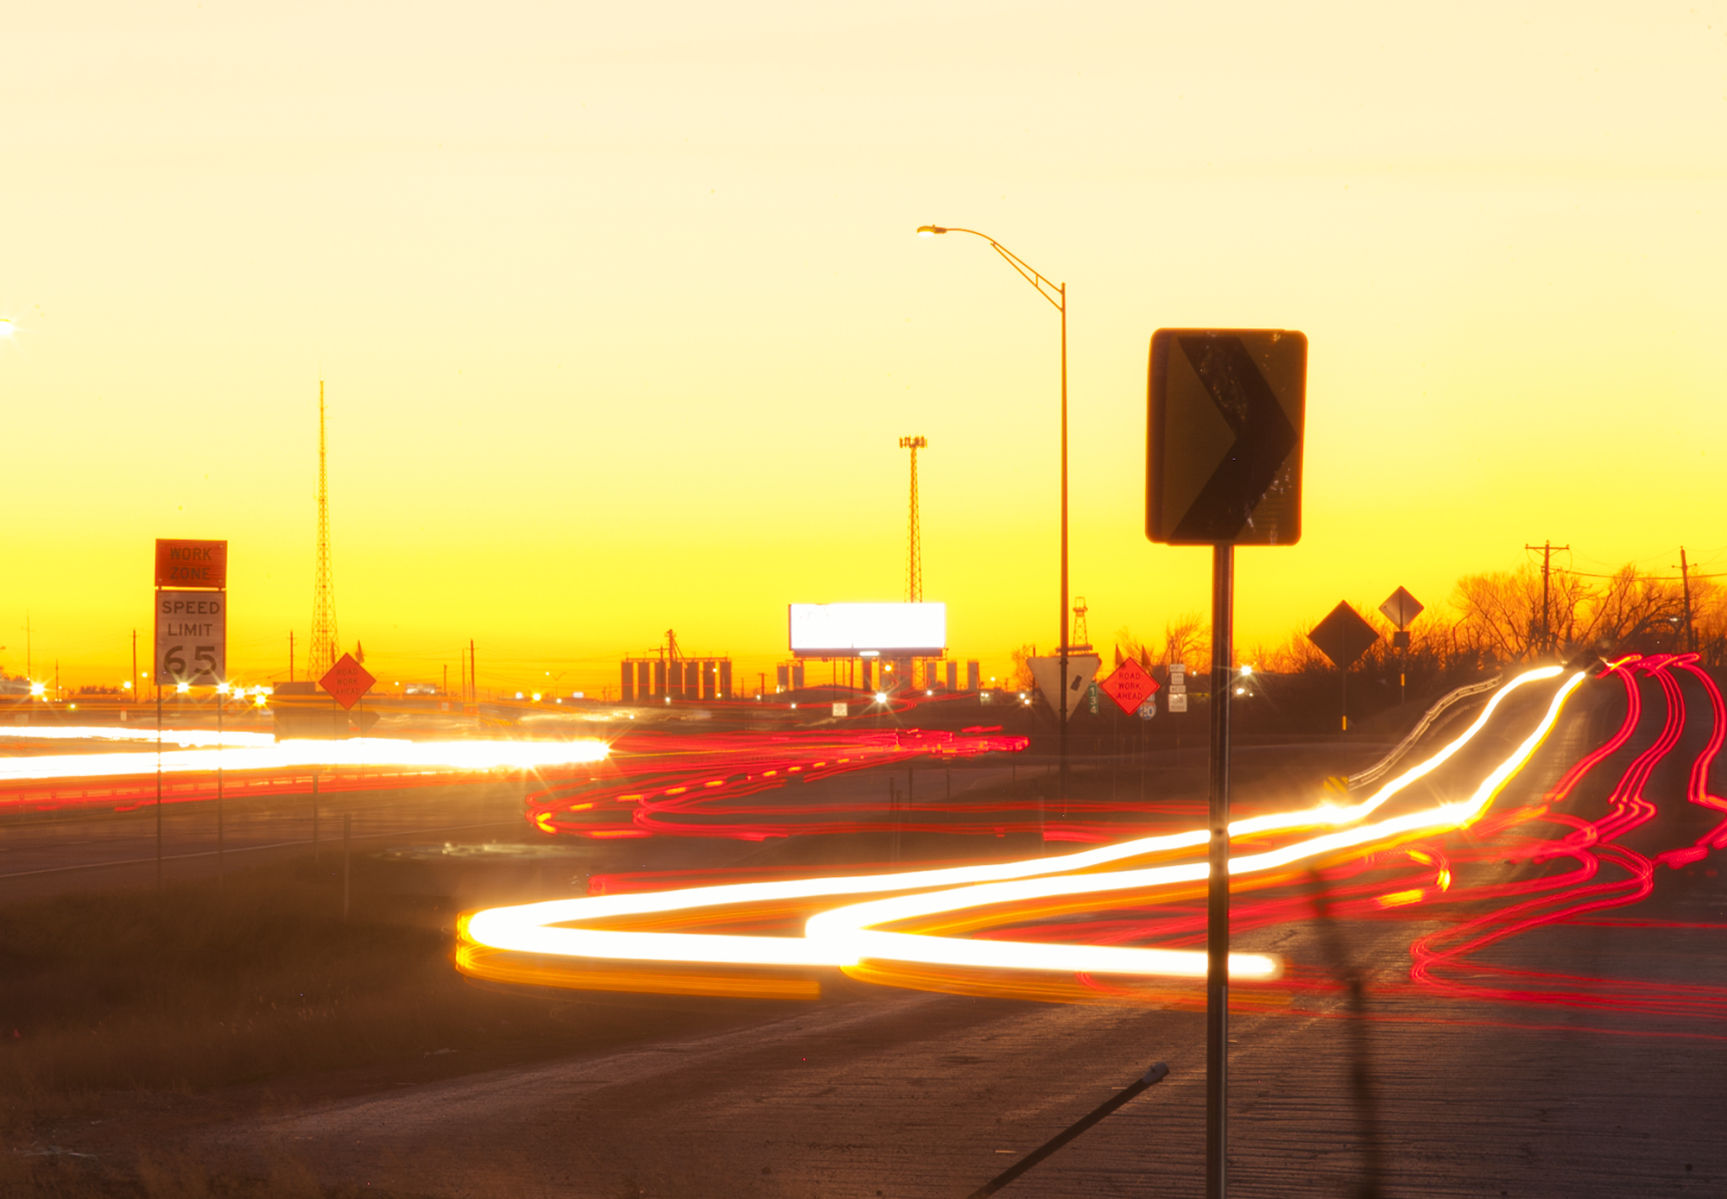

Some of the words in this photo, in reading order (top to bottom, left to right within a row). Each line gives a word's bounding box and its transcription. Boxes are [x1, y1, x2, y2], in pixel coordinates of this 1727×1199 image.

[170, 547, 212, 561] WORK
[169, 567, 210, 580] ZONE
[162, 601, 220, 615] SPEED
[168, 623, 213, 637] LIMIT
[163, 645, 217, 676] 65
[1118, 672, 1141, 680] ROAD
[1118, 682, 1142, 690] WORK
[1117, 692, 1143, 700] AHEAD
